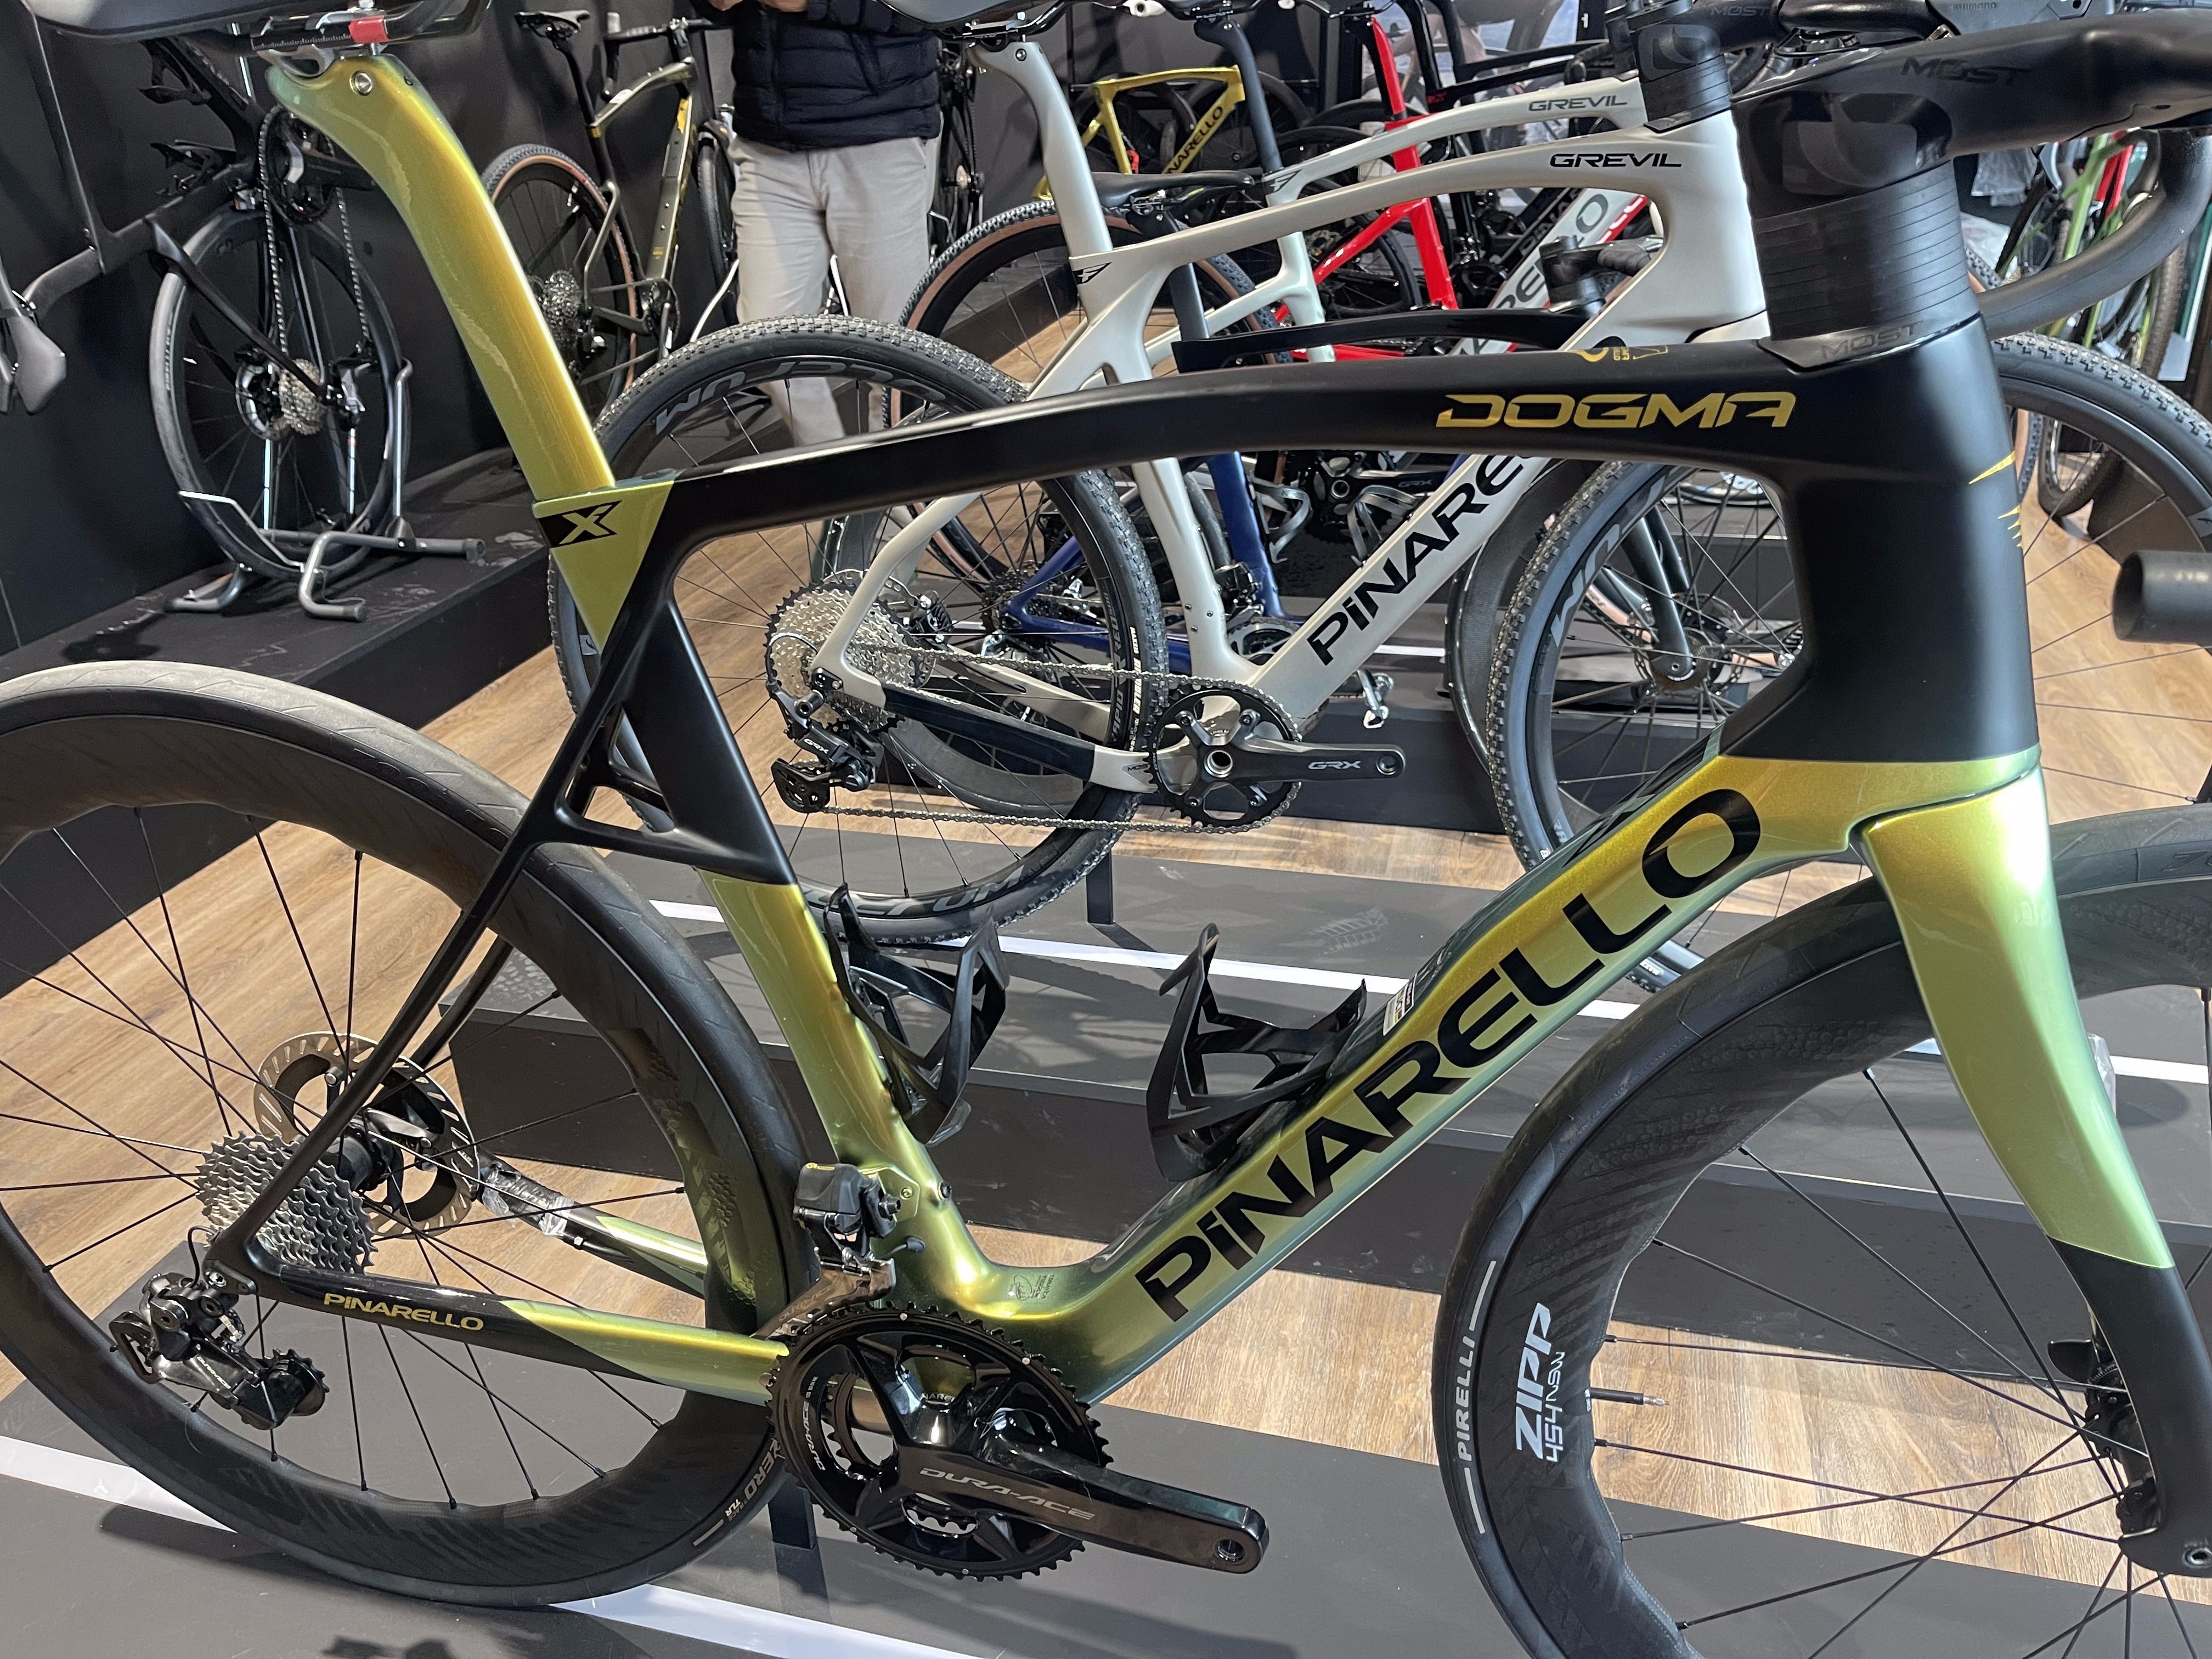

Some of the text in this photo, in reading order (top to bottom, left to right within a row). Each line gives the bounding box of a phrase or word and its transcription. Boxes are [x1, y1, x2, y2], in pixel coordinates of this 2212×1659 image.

[1528, 95, 1628, 112] GREVIL
[1165, 106, 1223, 173] NARELLO
[1549, 153, 1682, 167] GREVIL
[1435, 392, 1797, 428] DOGMA
[1307, 454, 1531, 666] PINARE
[804, 738, 830, 754] GRX
[1307, 760, 1362, 770] GRX
[1135, 788, 1761, 1322] PINARELLO
[323, 1293, 484, 1331] PINARELLO
[1455, 1335, 1475, 1462] PIRELLI
[1515, 1302, 1552, 1459] ZIPP
[1544, 1351, 1565, 1463] 454 NSW
[919, 1467, 1096, 1521] DURA-ACE
